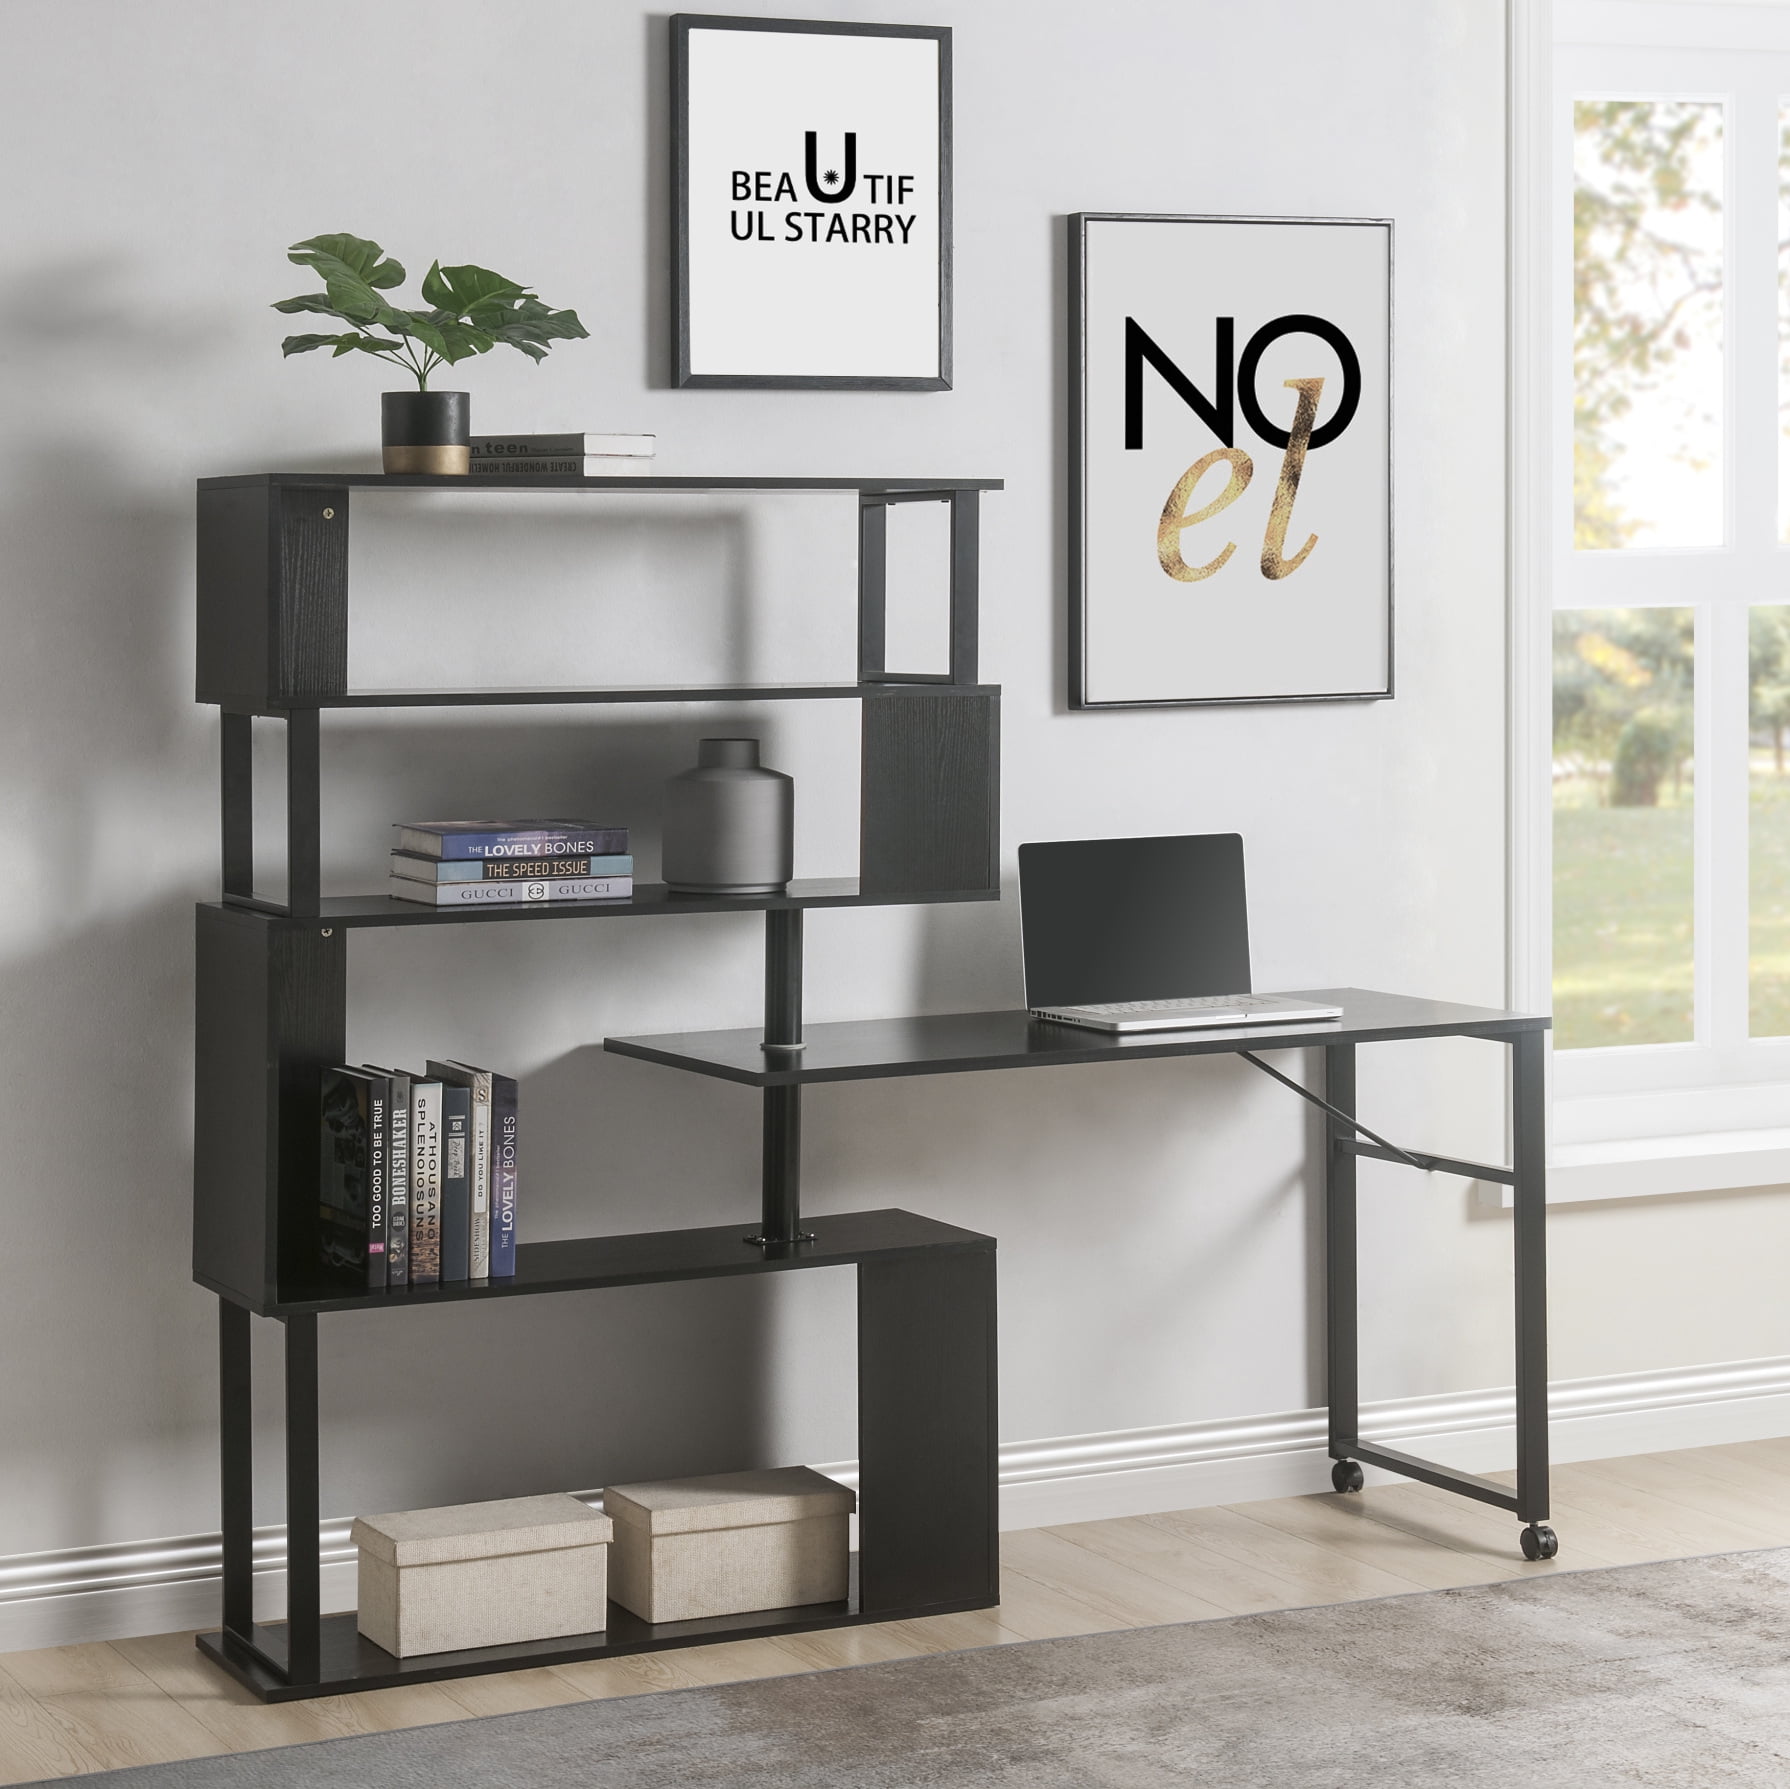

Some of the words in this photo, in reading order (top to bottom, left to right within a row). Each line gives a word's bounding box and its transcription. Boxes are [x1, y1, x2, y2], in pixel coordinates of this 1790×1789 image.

[731, 211, 775, 241] UL
[785, 211, 916, 244] STARRY
[1125, 314, 1361, 450] NO
[485, 442, 529, 454] teen
[502, 462, 549, 473] WONDERFUL
[551, 461, 577, 473] CREATE
[468, 846, 483, 854] THE
[484, 843, 541, 857] LOVELY
[544, 840, 594, 854] BONES
[487, 863, 509, 877] THE
[512, 862, 549, 876] SPEED
[552, 861, 588, 874] ISSUE
[461, 888, 514, 899] GUCCI
[558, 883, 610, 895] GUCCI
[373, 1099, 383, 1130] TRUE
[373, 1132, 383, 1148] BE
[479, 1130, 484, 1138] IT
[503, 1116, 516, 1168] BONES
[373, 1150, 382, 1166] TO
[391, 1109, 407, 1206] BONESHAKER
[372, 1169, 382, 1202] GOOD
[478, 1184, 483, 1197] DO
[502, 1172, 514, 1231] LOVELY
[372, 1205, 382, 1229] TOO
[501, 1233, 509, 1249] THE
